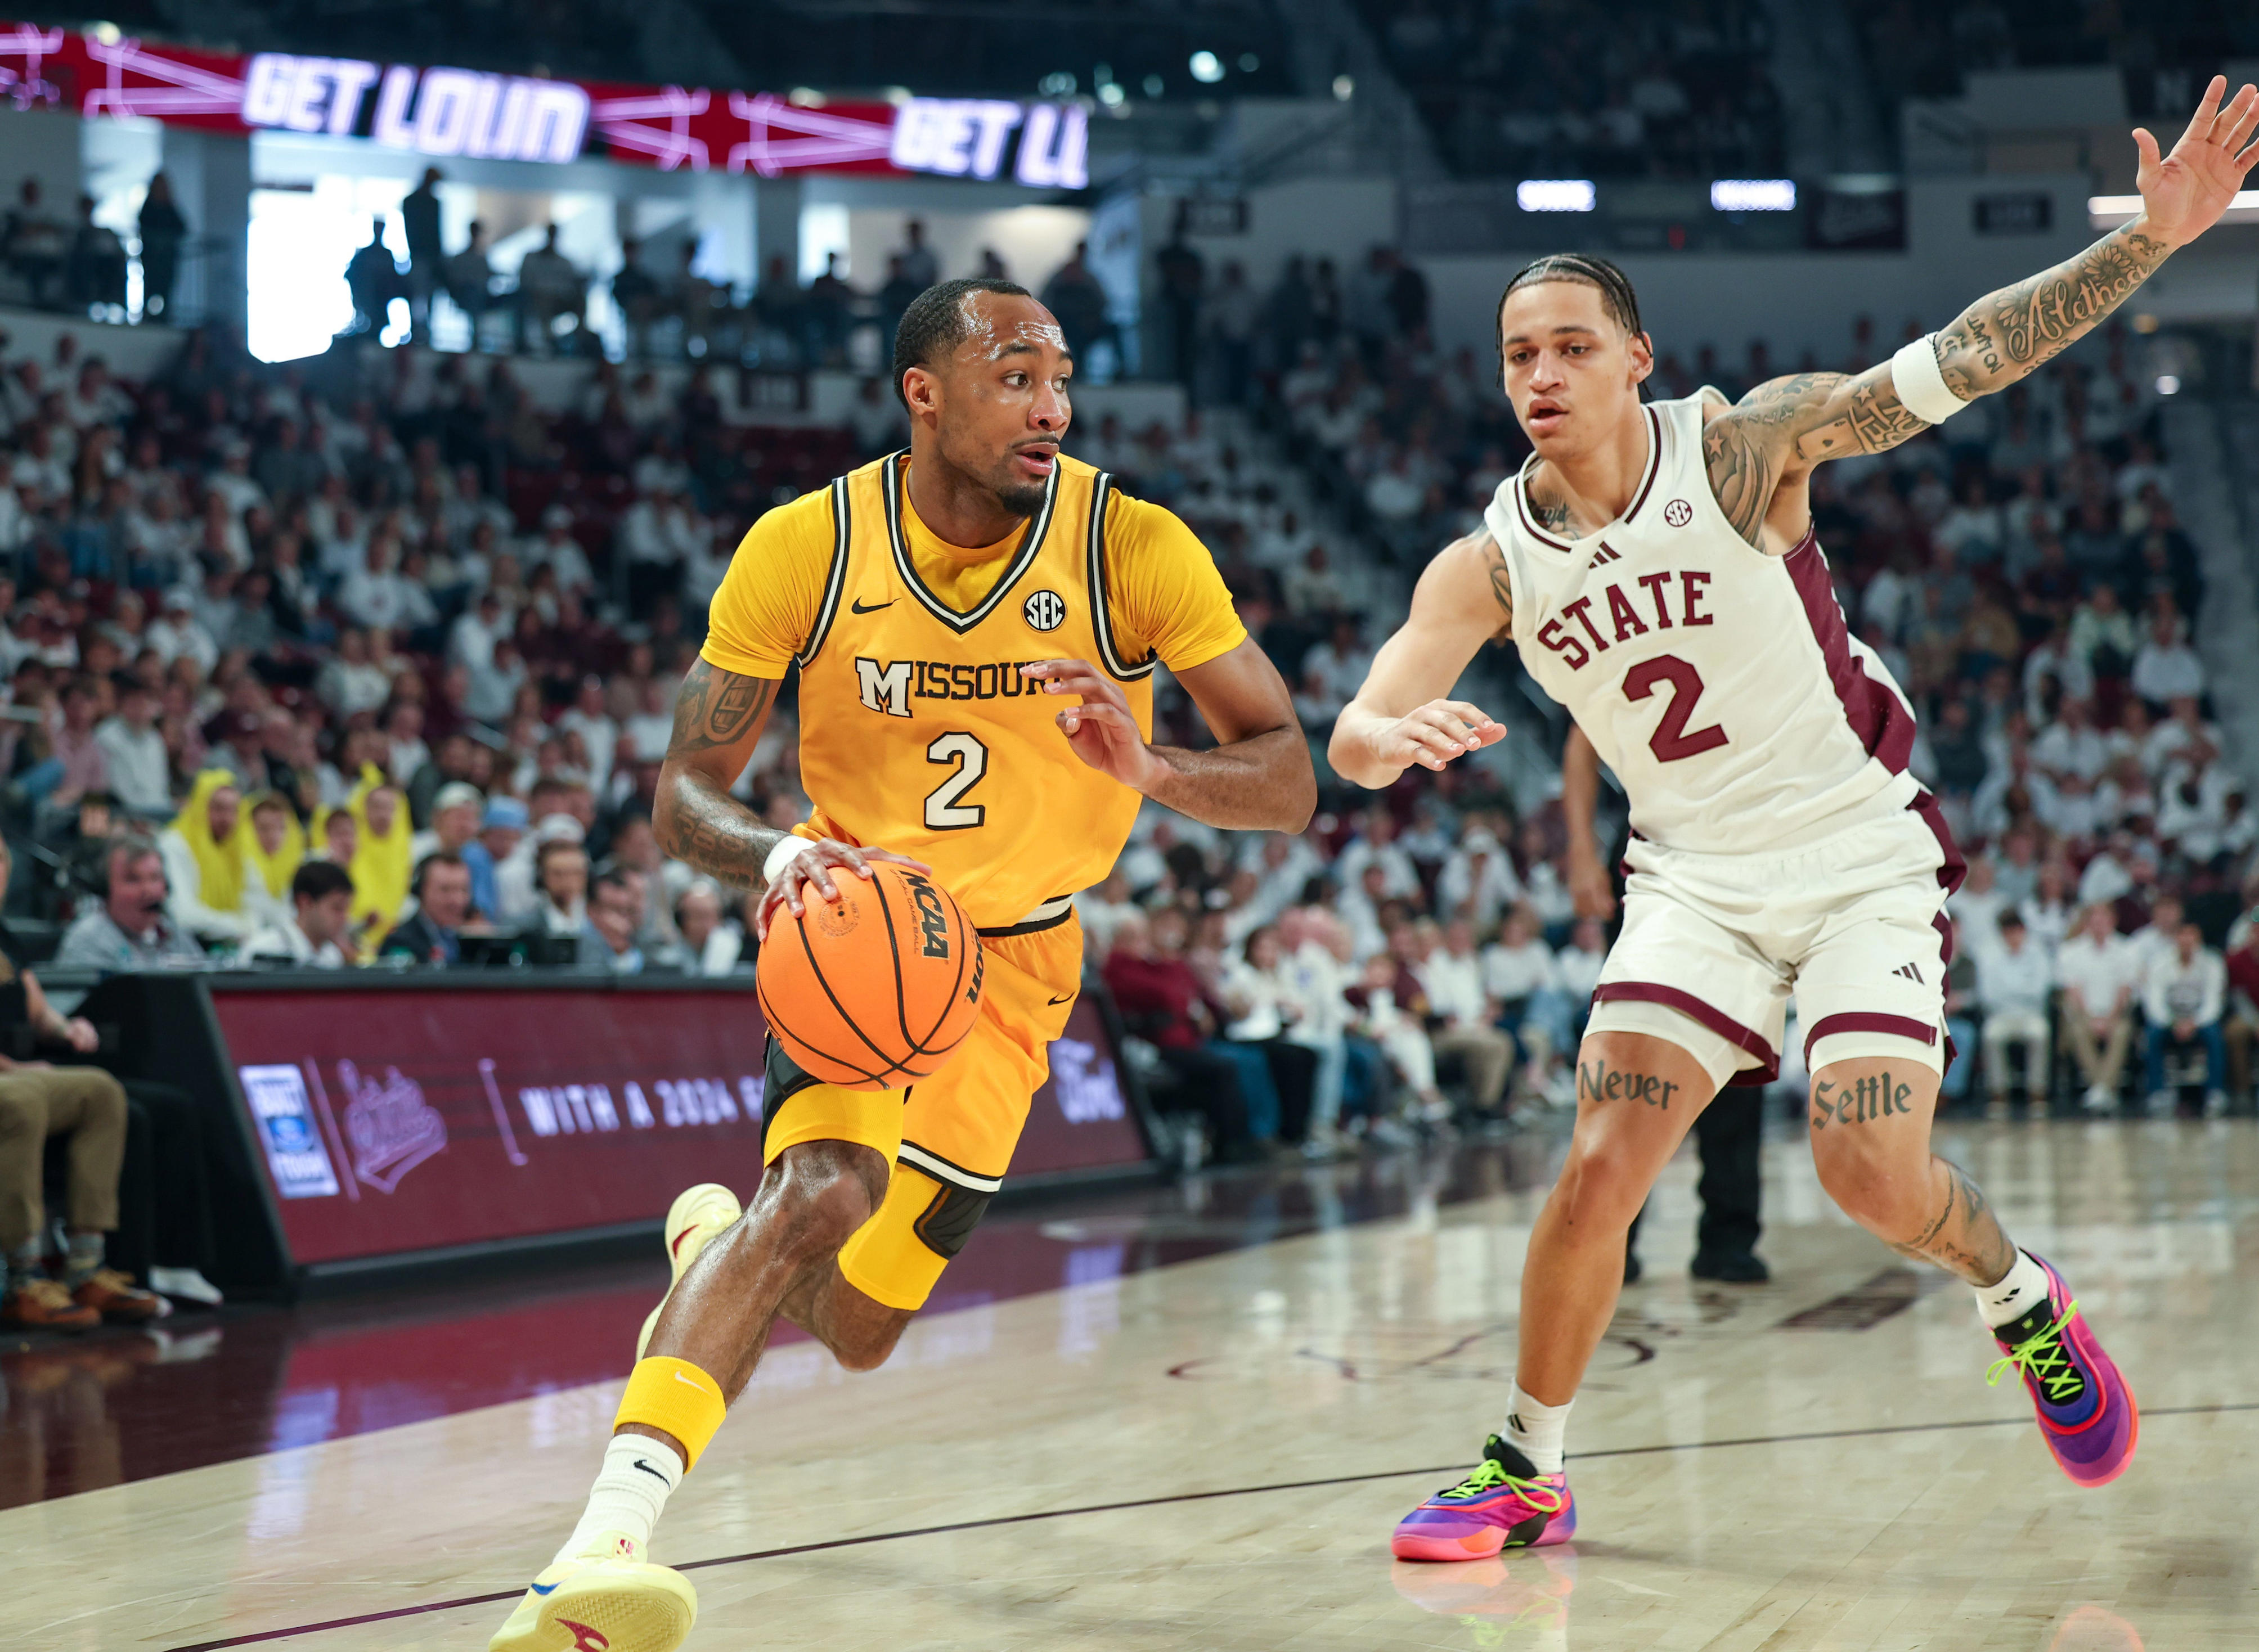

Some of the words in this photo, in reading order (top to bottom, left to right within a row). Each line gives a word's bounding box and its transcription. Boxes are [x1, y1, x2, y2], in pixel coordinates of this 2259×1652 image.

[243, 53, 381, 136] GET
[890, 97, 1021, 181] GET
[1665, 500, 1692, 526] SEC
[1025, 590, 1065, 631] SEC
[1538, 571, 1713, 670] STATE
[855, 656, 1060, 718] MISSOUR
[1622, 654, 1729, 763] 2
[924, 731, 989, 831] 2
[899, 870, 950, 960] NCAA
[519, 1083, 620, 1137] WITH
[625, 1081, 655, 1129] A
[1580, 1059, 1679, 1110] Never
[1813, 1072, 1912, 1130] Settle
